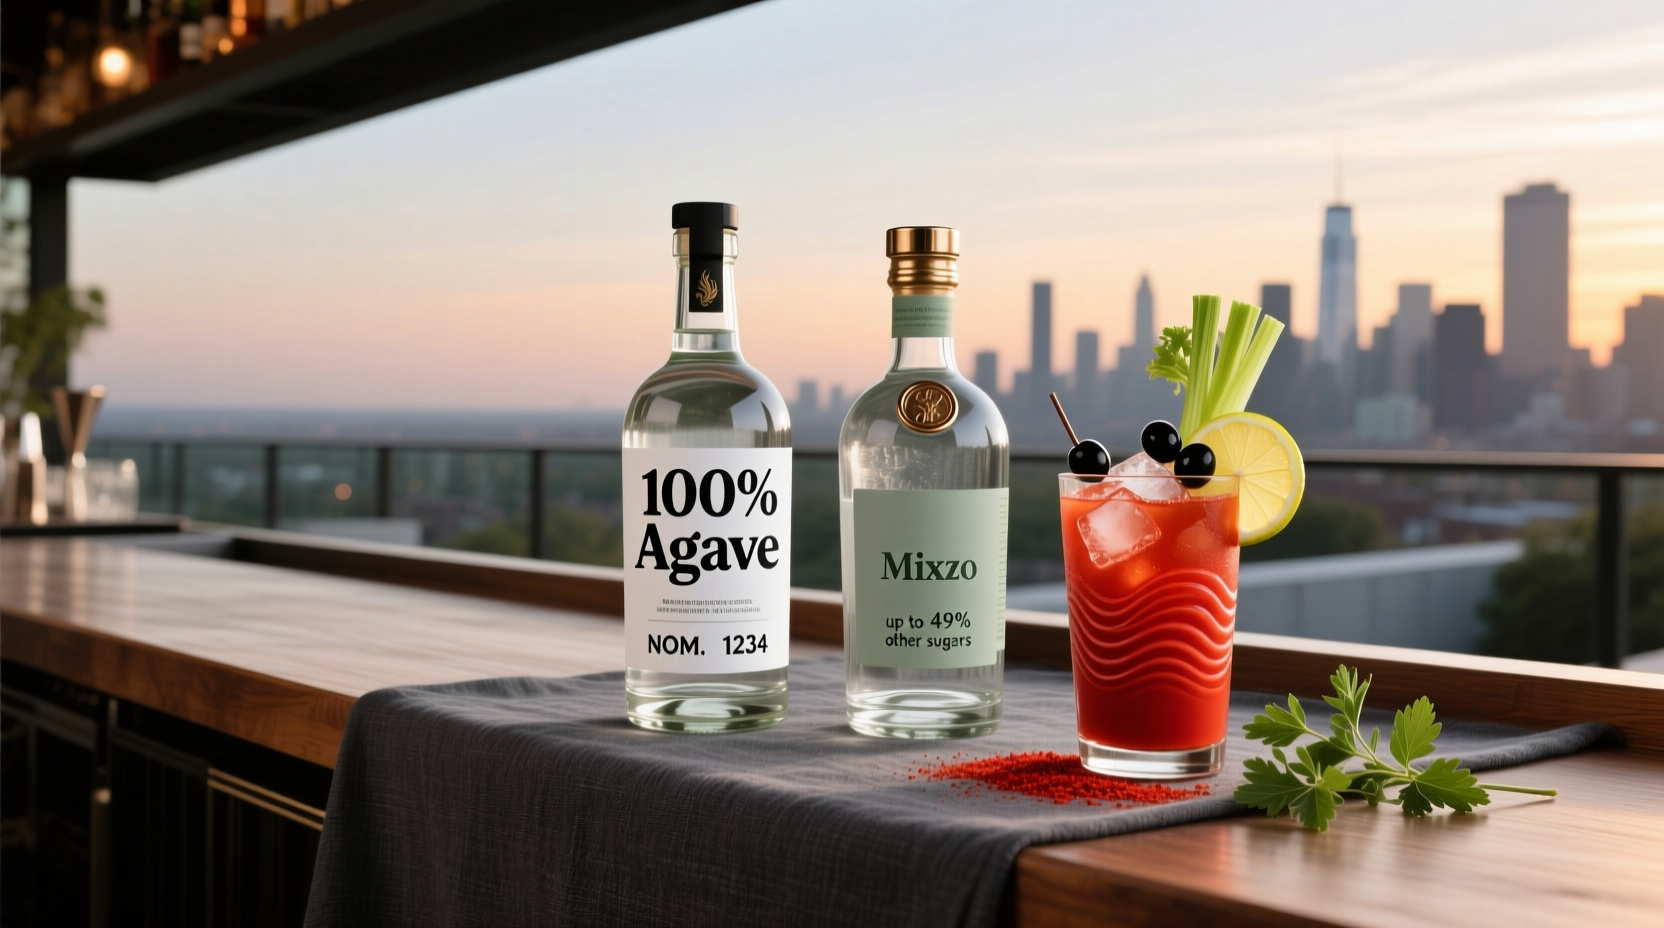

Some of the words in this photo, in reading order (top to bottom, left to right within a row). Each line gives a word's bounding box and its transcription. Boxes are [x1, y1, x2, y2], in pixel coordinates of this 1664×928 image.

[641, 468, 778, 518] 100%
[634, 522, 780, 587] Agave
[880, 551, 978, 581] Mixzo
[886, 616, 904, 632] up
[908, 615, 924, 630] to
[930, 611, 971, 630] 49%
[647, 633, 706, 656] NOM.
[723, 633, 769, 656] 1234
[885, 632, 922, 648] other
[927, 636, 972, 652] sugars
